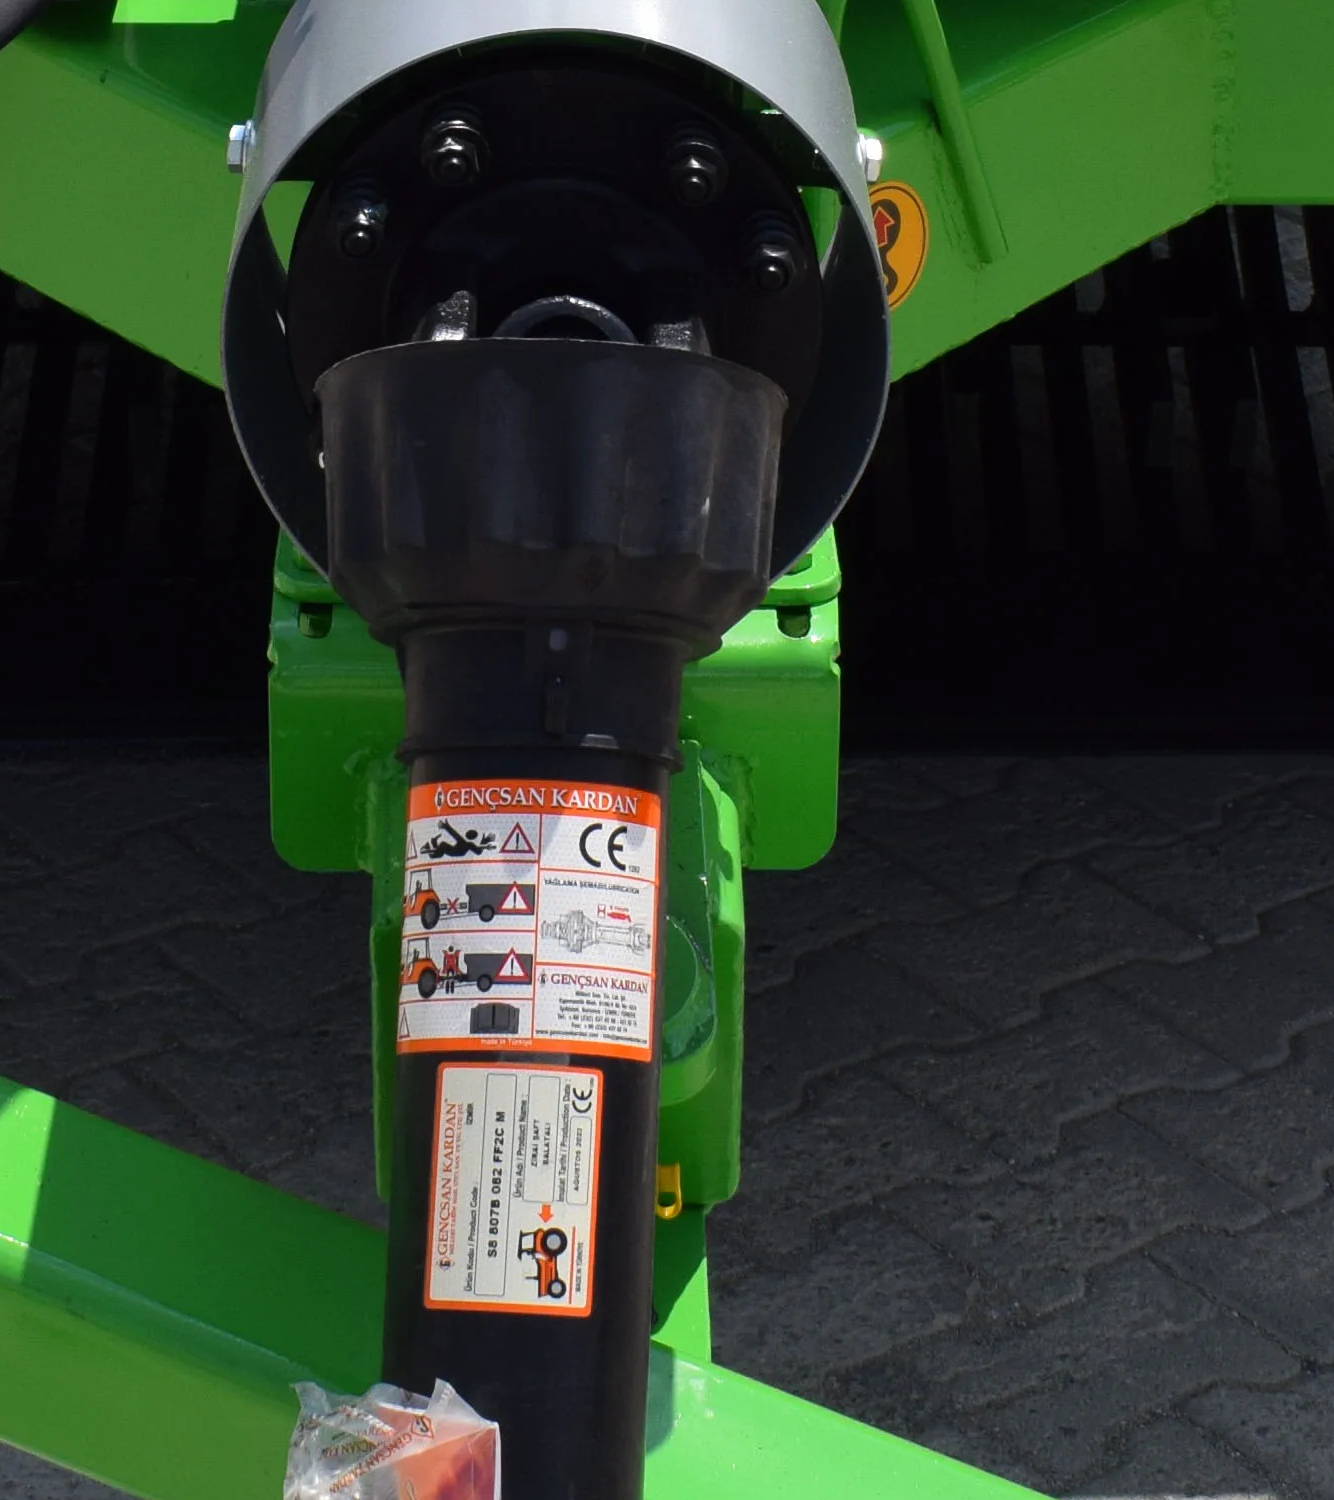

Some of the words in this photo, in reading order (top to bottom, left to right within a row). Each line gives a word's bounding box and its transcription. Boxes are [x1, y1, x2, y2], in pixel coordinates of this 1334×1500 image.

[446, 786, 545, 813] GENÇSAN
[551, 788, 638, 815] KARDAN
[551, 973, 609, 991] GENÇSAN
[611, 977, 649, 994] KARDAN
[495, 1111, 505, 1122] M
[440, 1102, 456, 1173] KARDAN
[492, 1128, 504, 1163] FF2C
